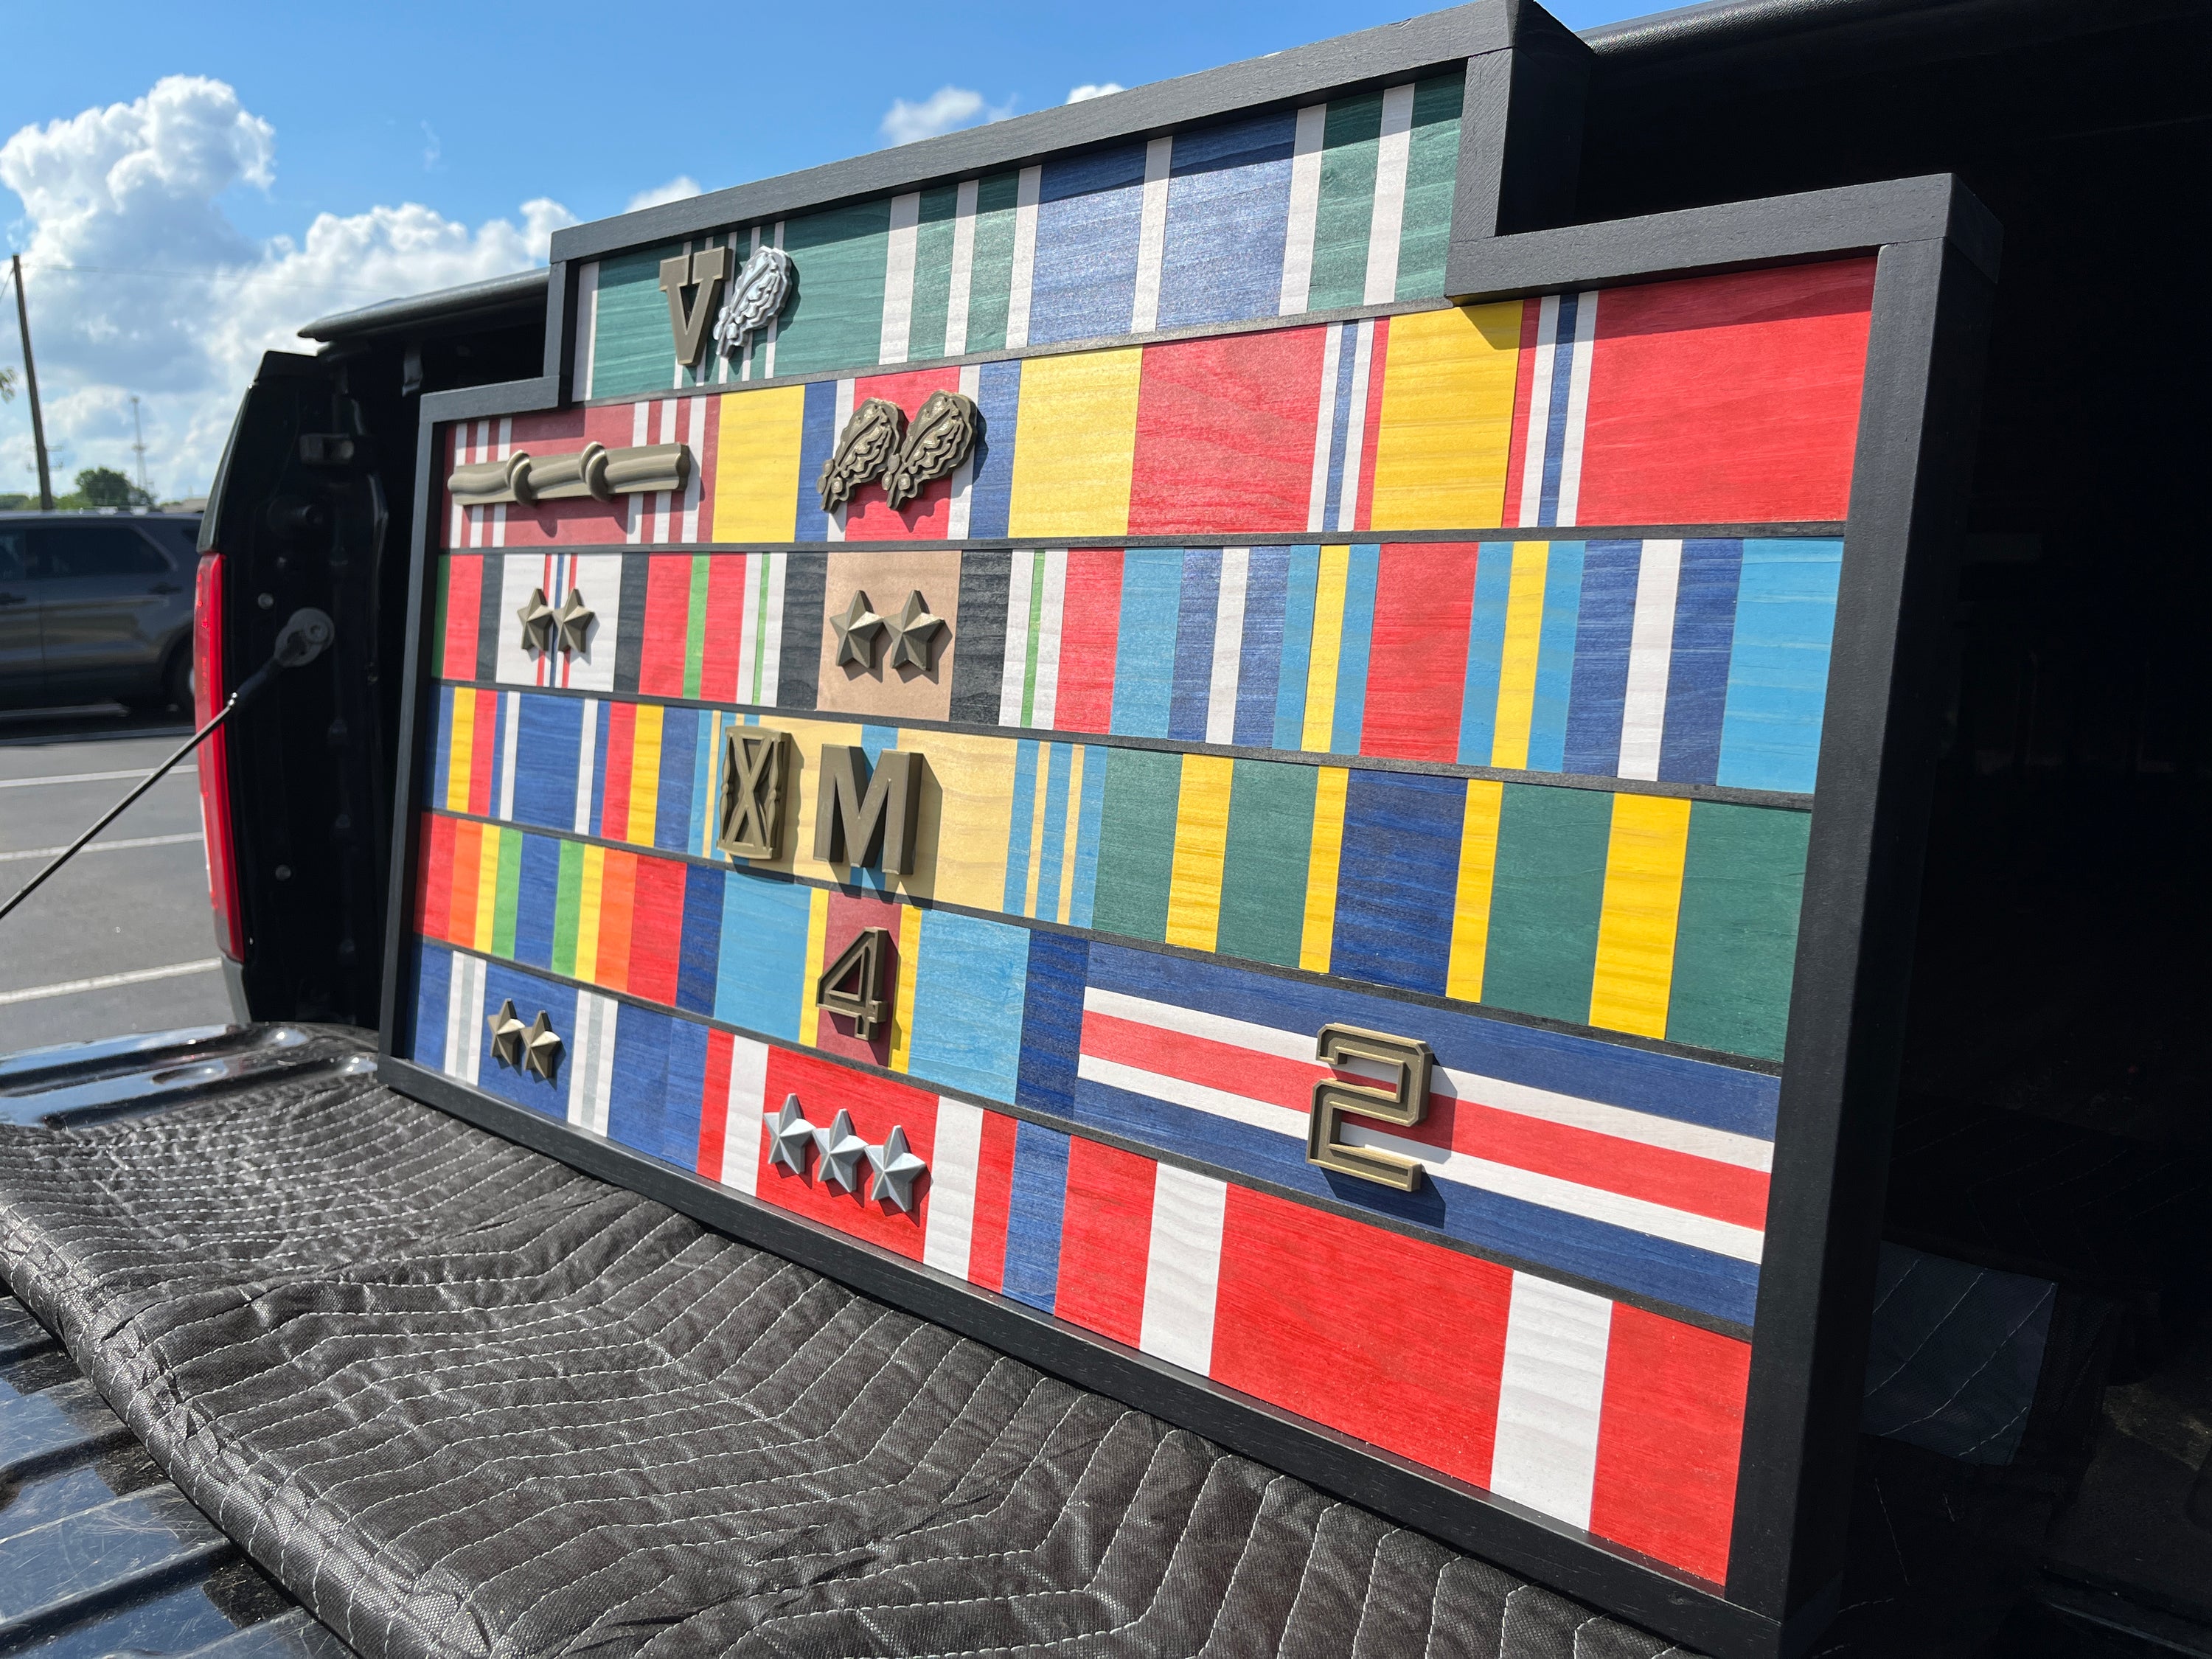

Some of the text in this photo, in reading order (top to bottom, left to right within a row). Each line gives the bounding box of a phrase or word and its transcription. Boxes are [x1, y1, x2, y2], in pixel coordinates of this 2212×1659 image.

[659, 246, 732, 366] V
[813, 743, 922, 875] M
[815, 926, 888, 1041] 4
[1306, 1022, 1433, 1192] 2
